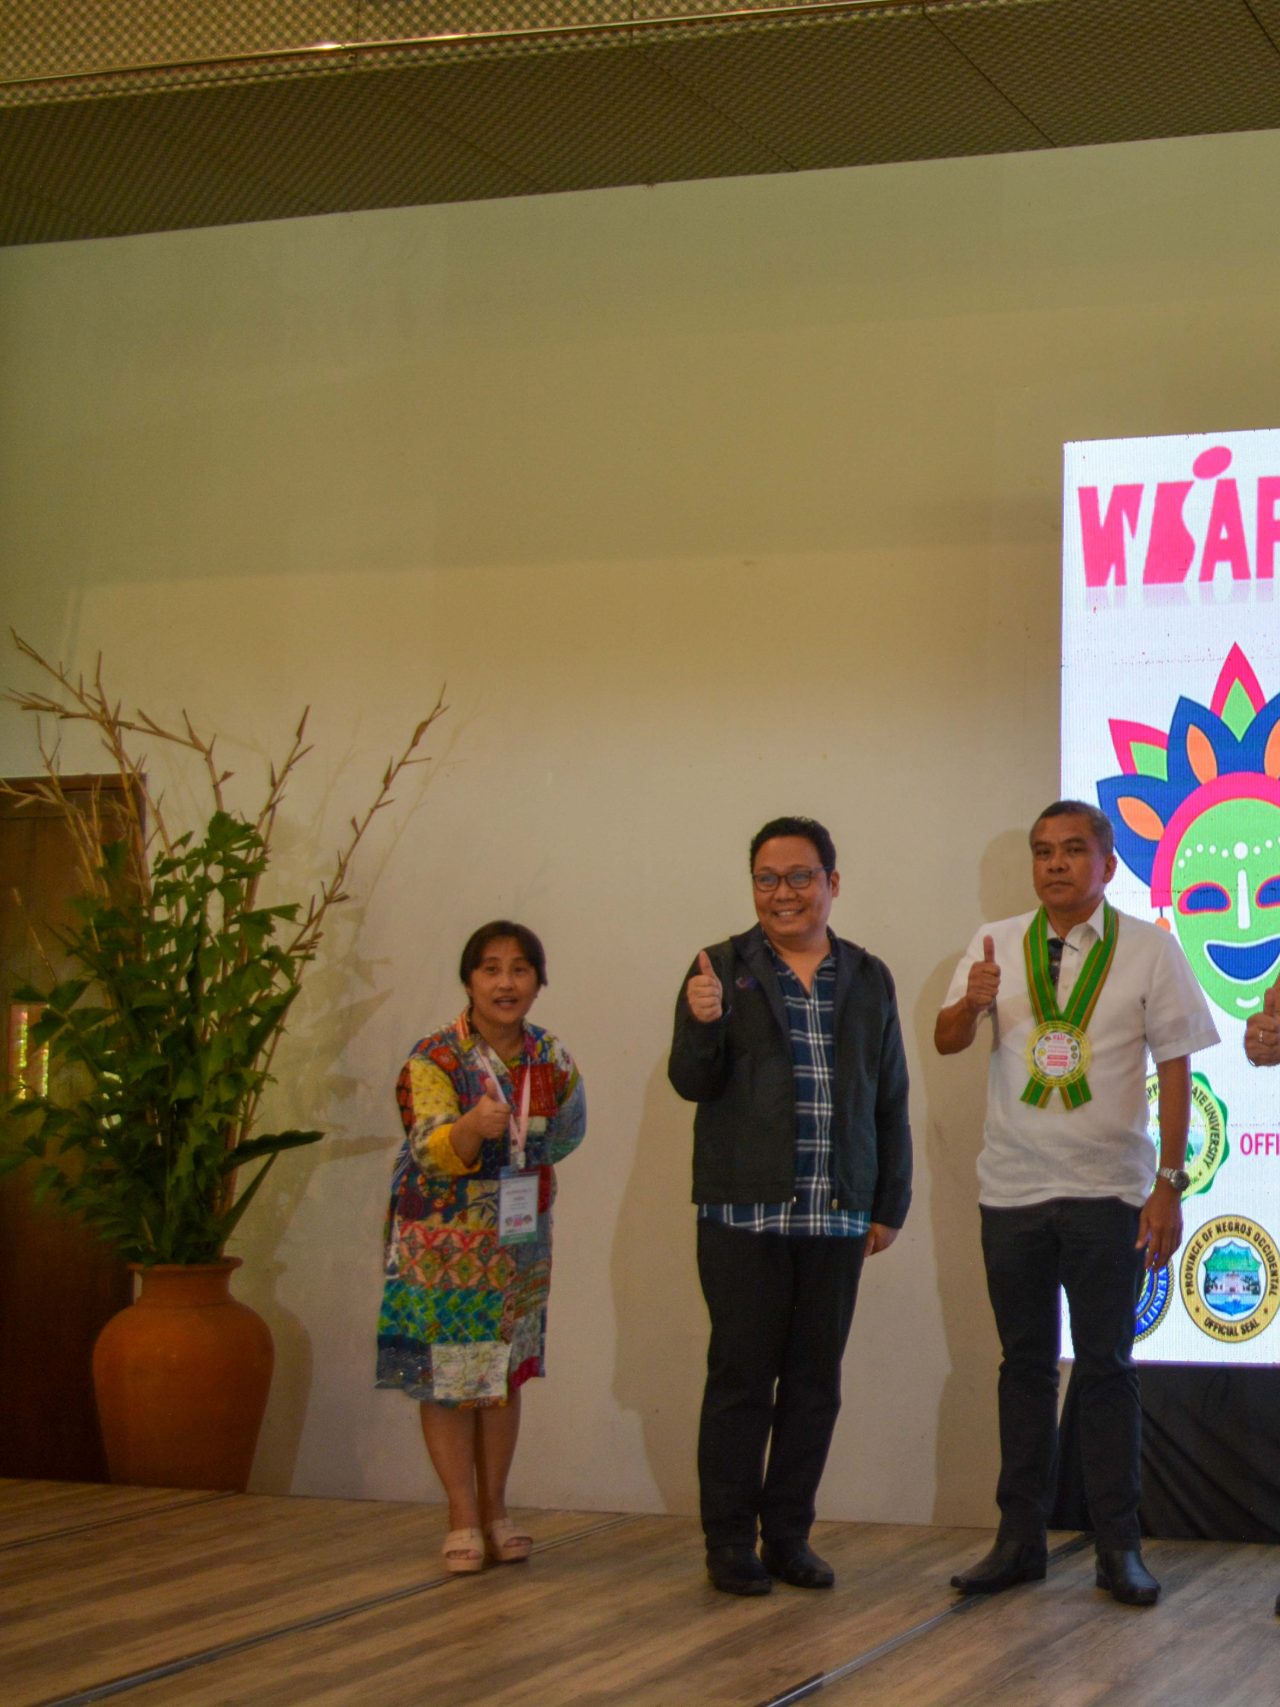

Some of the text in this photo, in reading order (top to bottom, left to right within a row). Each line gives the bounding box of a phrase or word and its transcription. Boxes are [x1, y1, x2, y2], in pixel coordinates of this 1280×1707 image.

[1203, 1102, 1221, 1169] UNIVERSITY
[1184, 1221, 1280, 1296] PROVINCE OF NEGROS OCCIDENTAL
[1204, 1317, 1260, 1337] OFFICIAL SEAL
